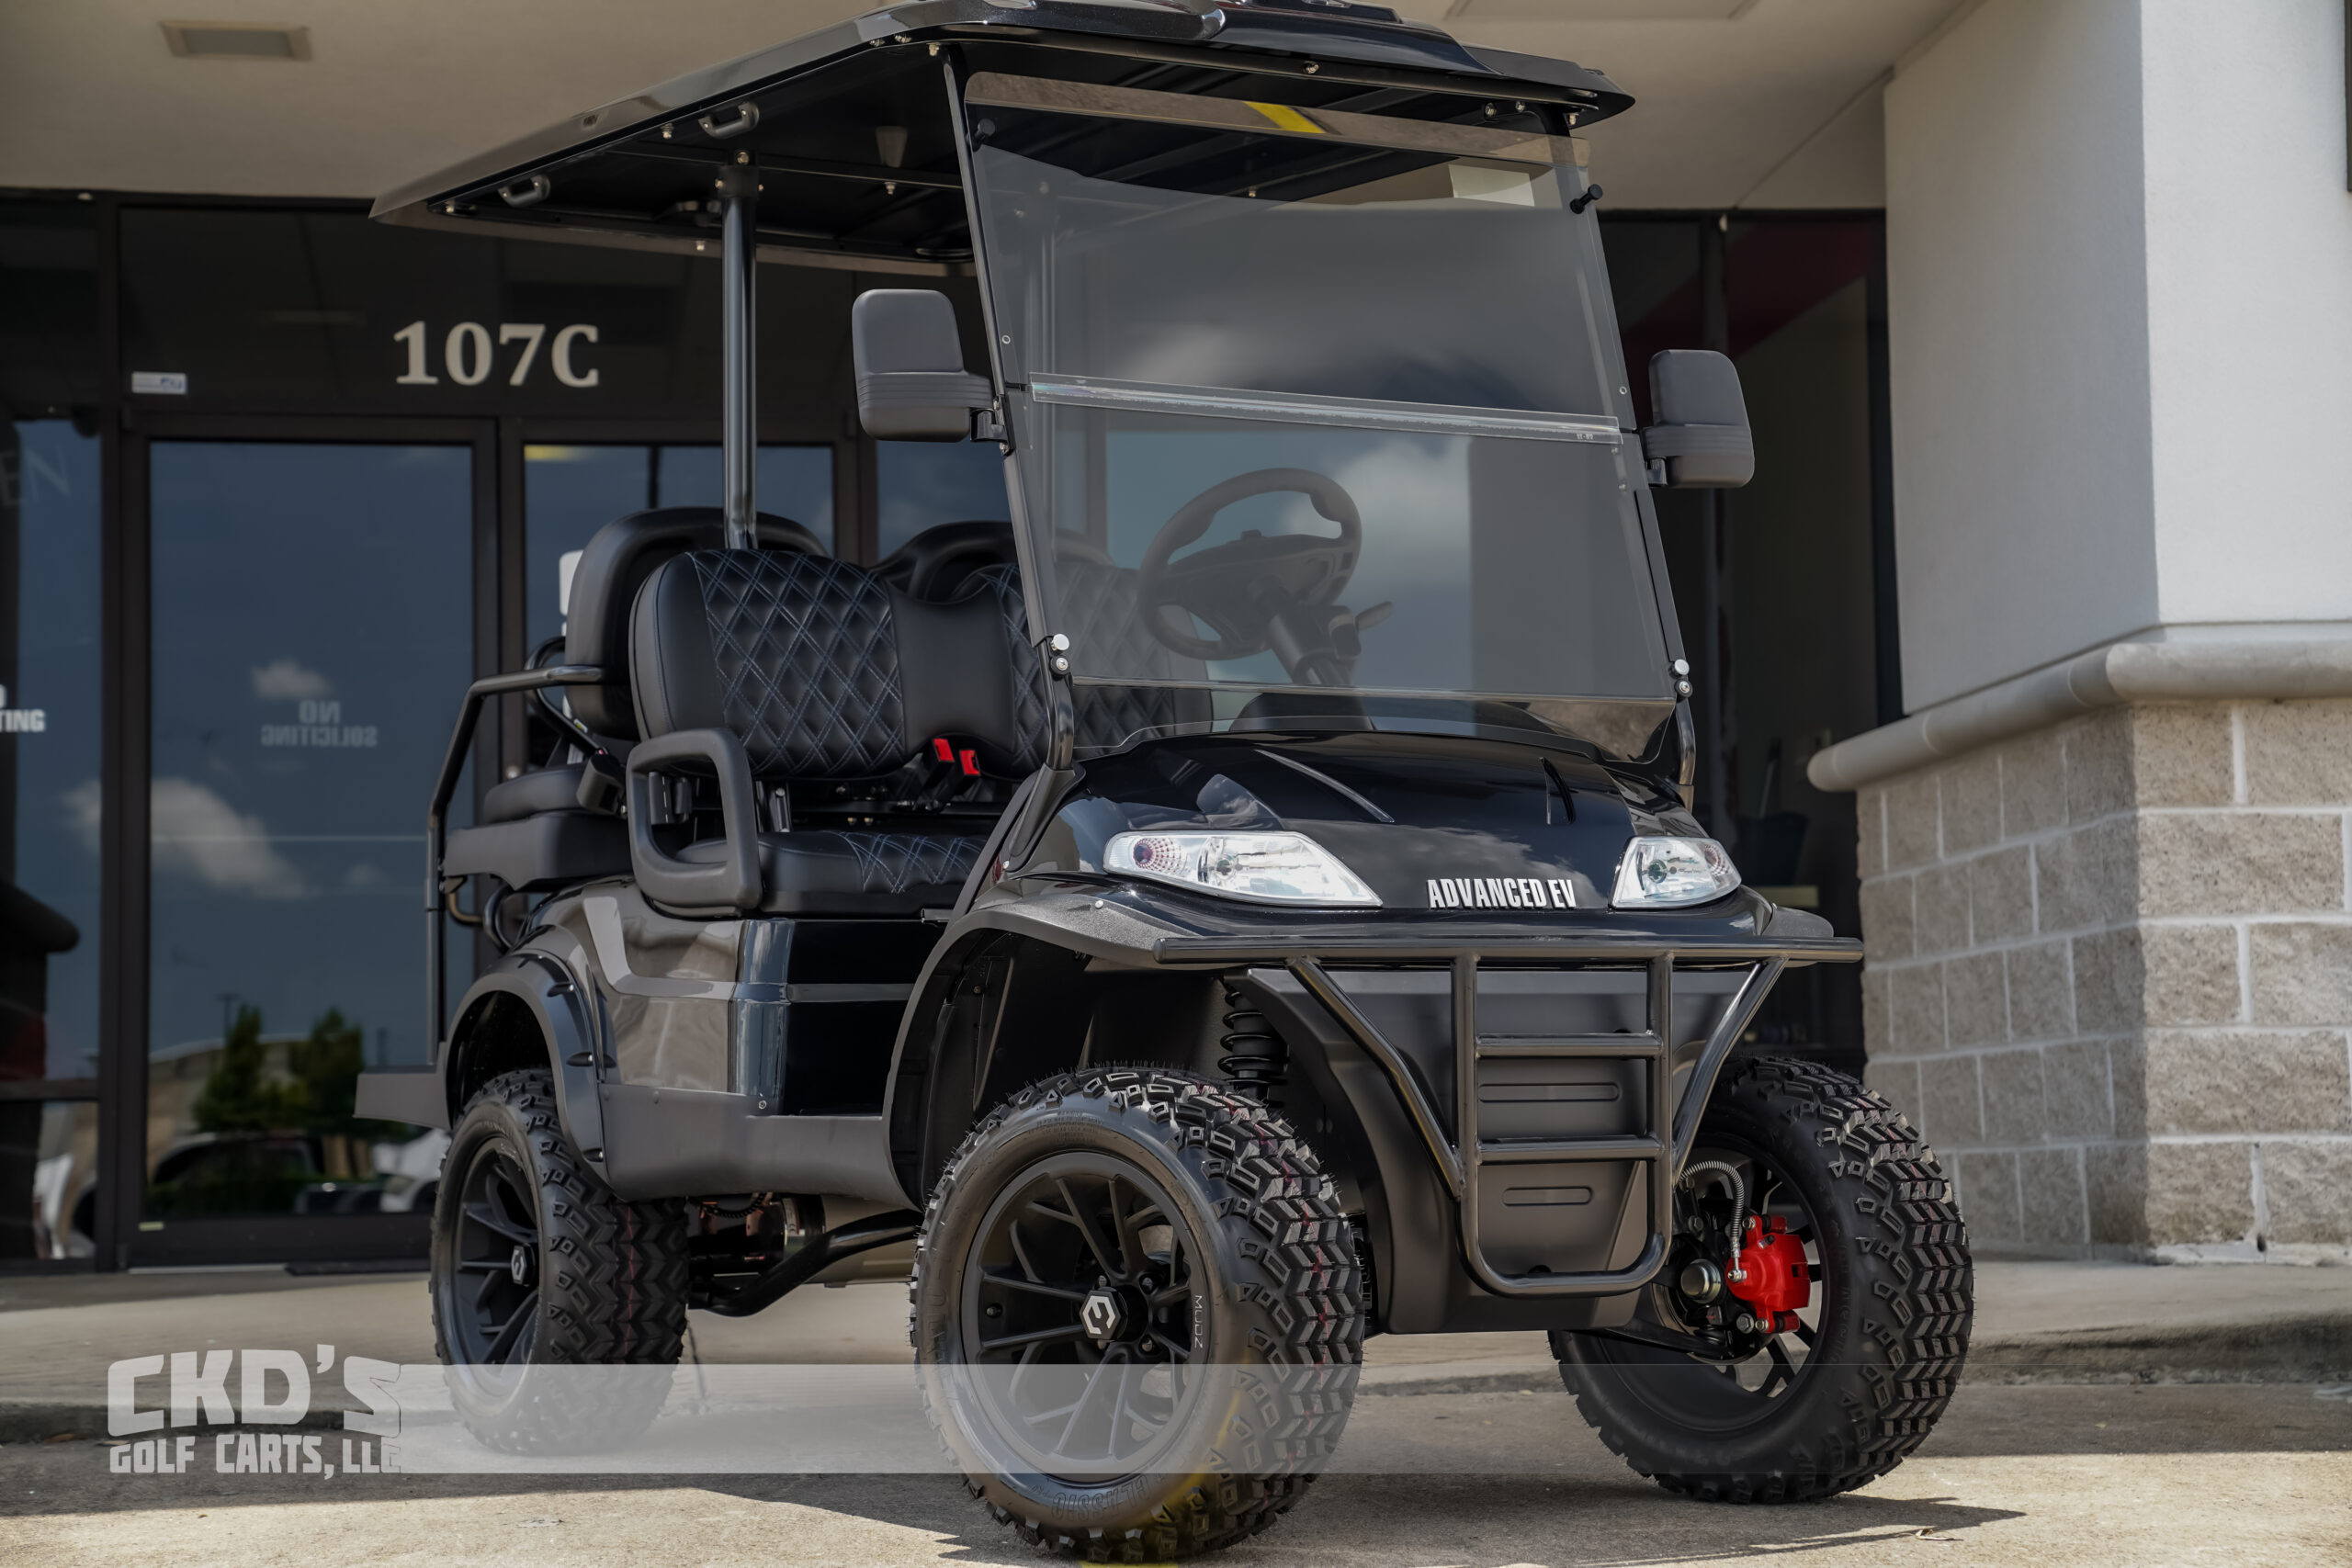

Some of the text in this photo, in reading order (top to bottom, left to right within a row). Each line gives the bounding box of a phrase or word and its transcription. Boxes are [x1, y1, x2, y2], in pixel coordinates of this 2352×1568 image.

[393, 321, 599, 388] 107C
[1427, 878, 1577, 909] ADVANCED EV
